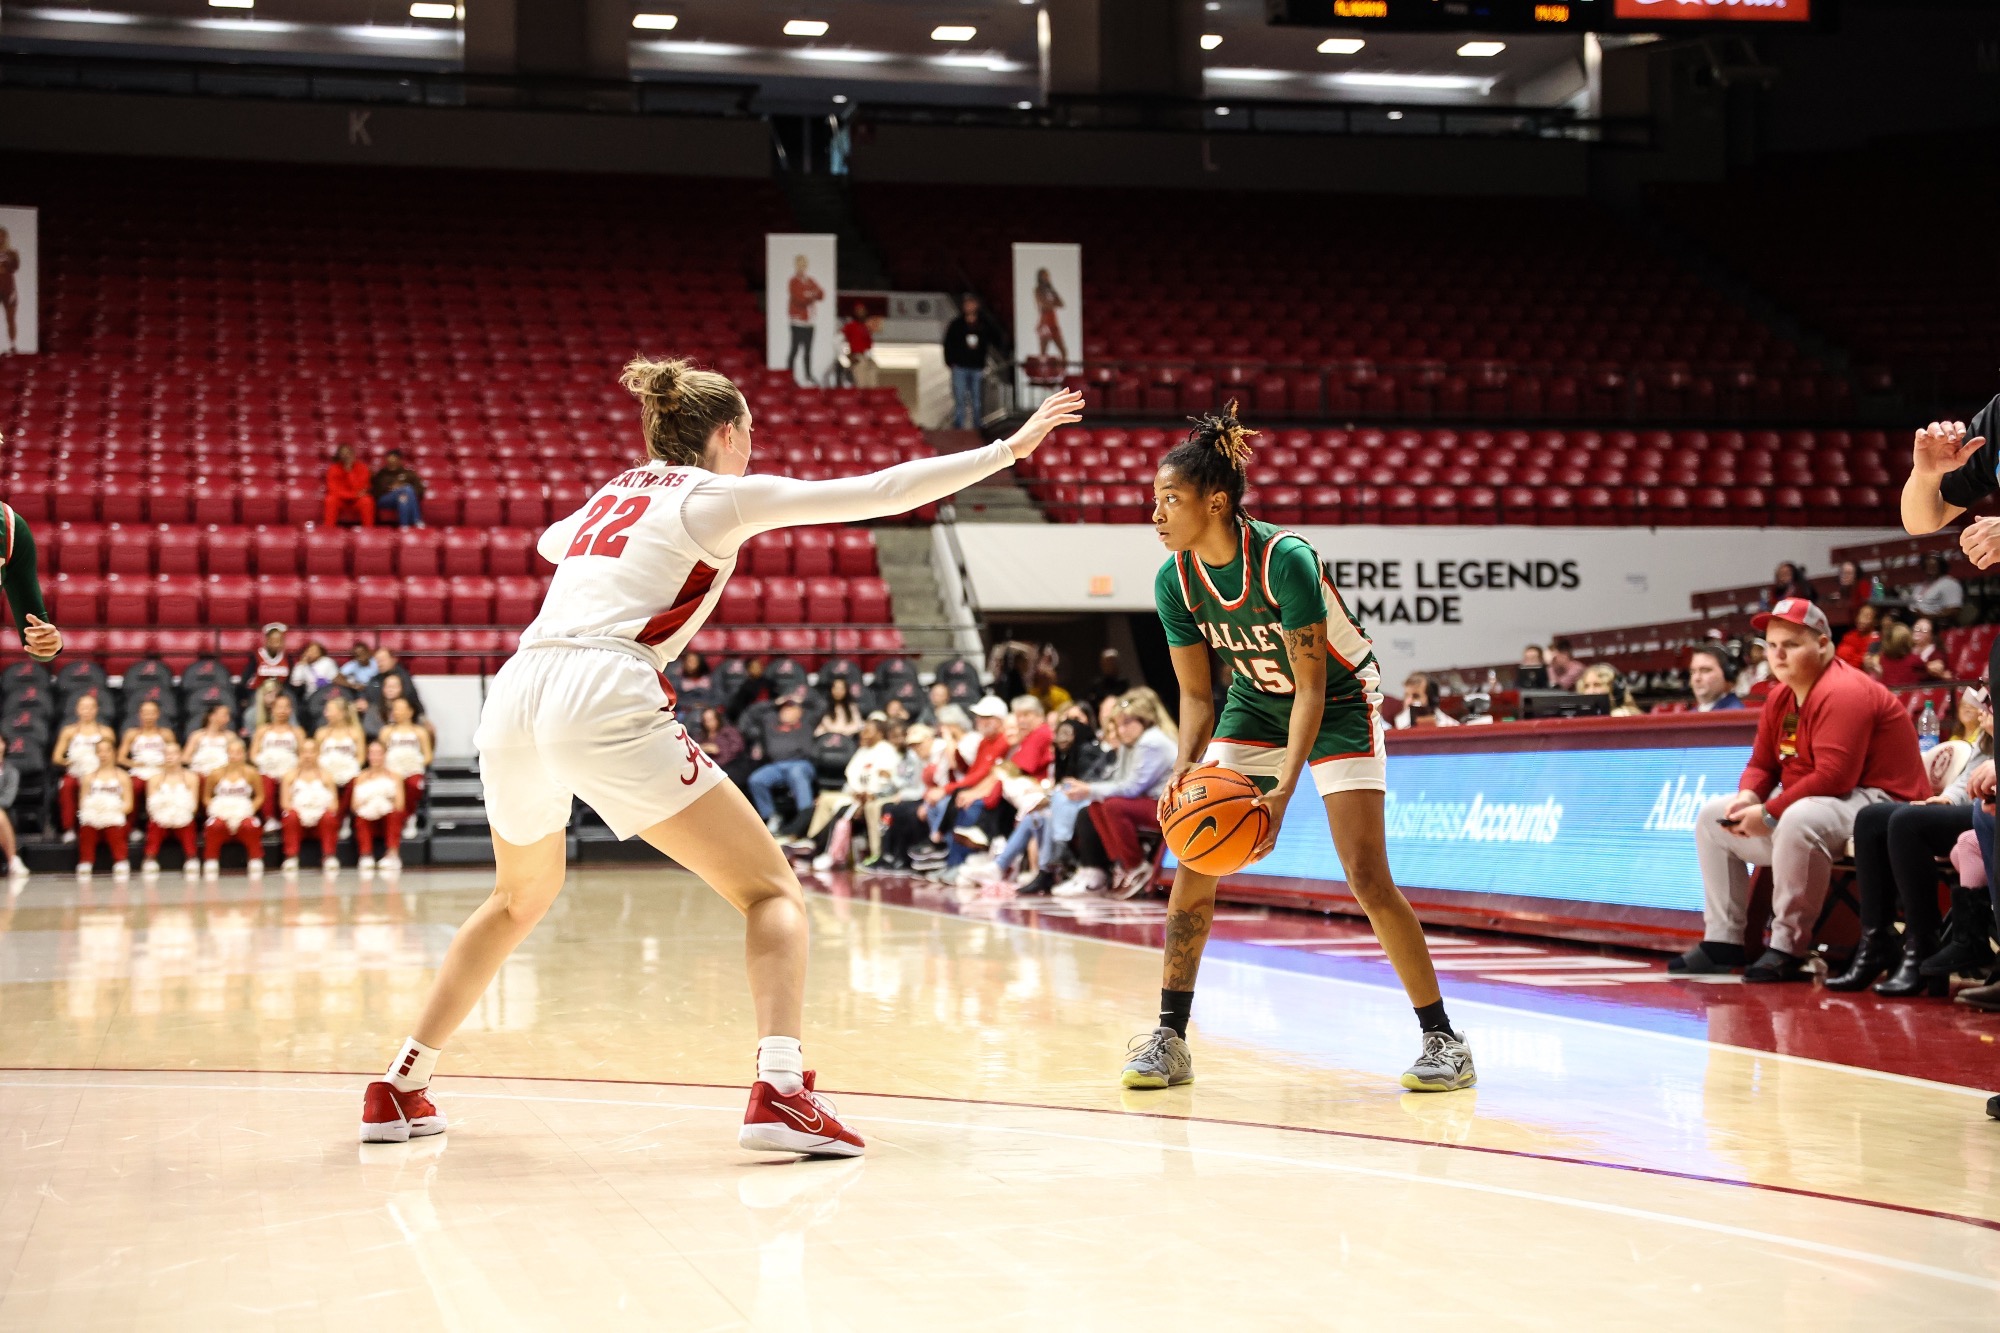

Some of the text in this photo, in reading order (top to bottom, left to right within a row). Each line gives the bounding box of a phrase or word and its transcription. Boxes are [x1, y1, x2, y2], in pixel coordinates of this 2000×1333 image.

[349, 110, 372, 147] K
[564, 495, 651, 560] 22
[1326, 560, 1580, 589] ERE LEGENDS
[1357, 597, 1462, 623] MADE
[1233, 657, 1295, 694] 15
[1459, 792, 1563, 842] Accounts
[1643, 773, 1722, 831] Alab
